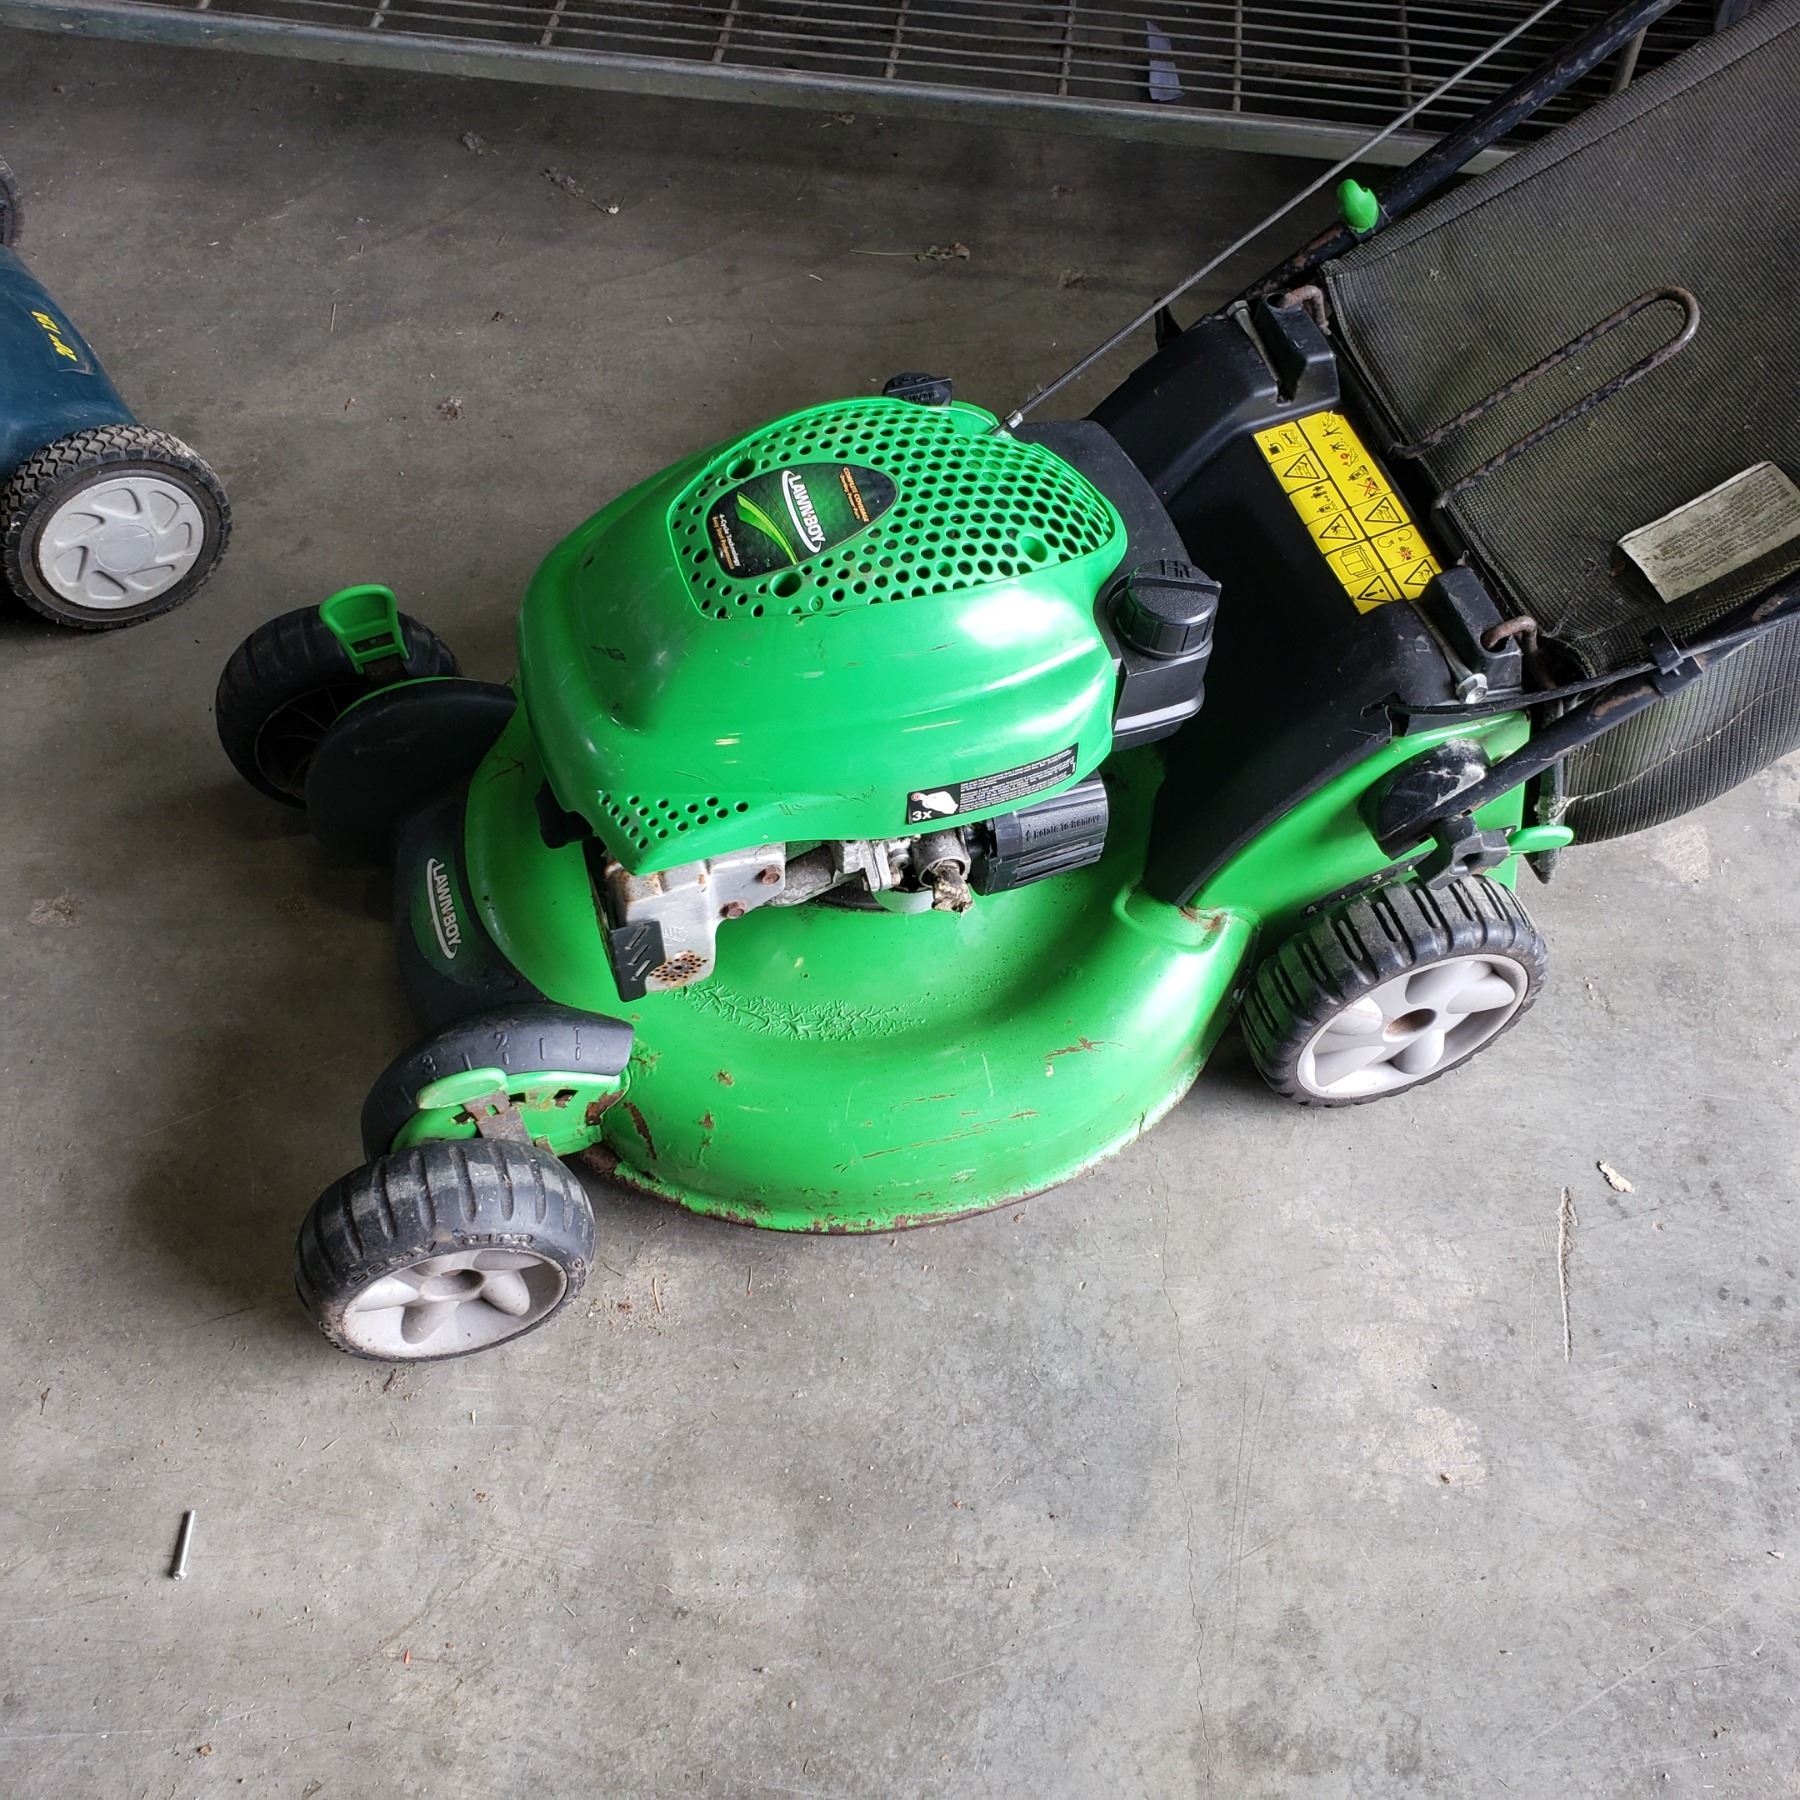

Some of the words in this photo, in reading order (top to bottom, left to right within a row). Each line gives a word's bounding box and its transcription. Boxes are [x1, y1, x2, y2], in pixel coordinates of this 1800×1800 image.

[911, 810, 932, 821] 3x
[421, 1054, 437, 1073] 3
[494, 1031, 509, 1052] 2
[572, 1026, 582, 1047] 1
